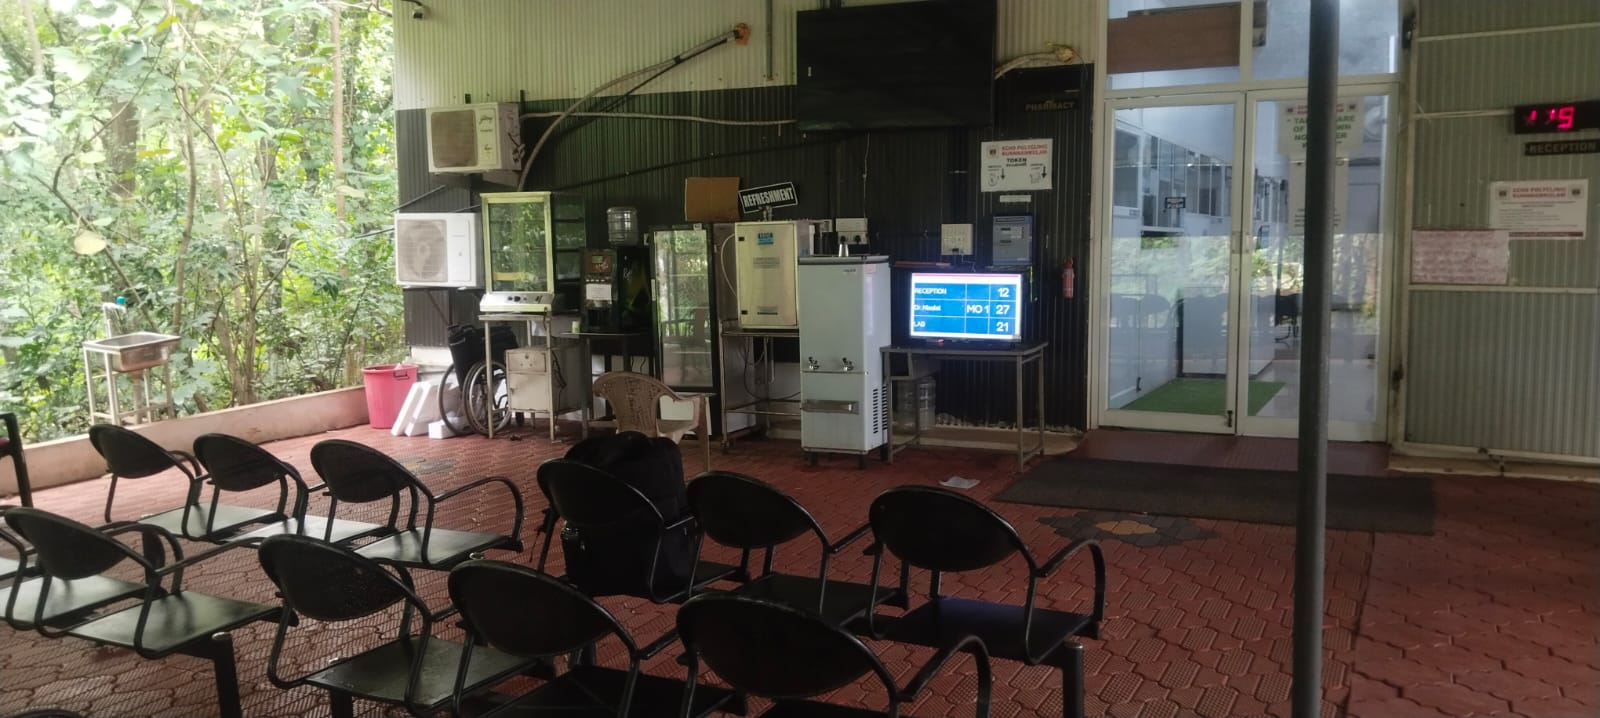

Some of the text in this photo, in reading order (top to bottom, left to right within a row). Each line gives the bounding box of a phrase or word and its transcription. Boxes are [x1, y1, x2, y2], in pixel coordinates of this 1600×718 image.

[1529, 142, 1597, 154] RECEPTION
[743, 187, 794, 208] REFRESHMENT
[914, 287, 947, 295] RECEPTION
[997, 287, 1009, 298] 12
[966, 304, 990, 314] MO 1
[995, 304, 1010, 315] 27
[996, 321, 1009, 332] 21
